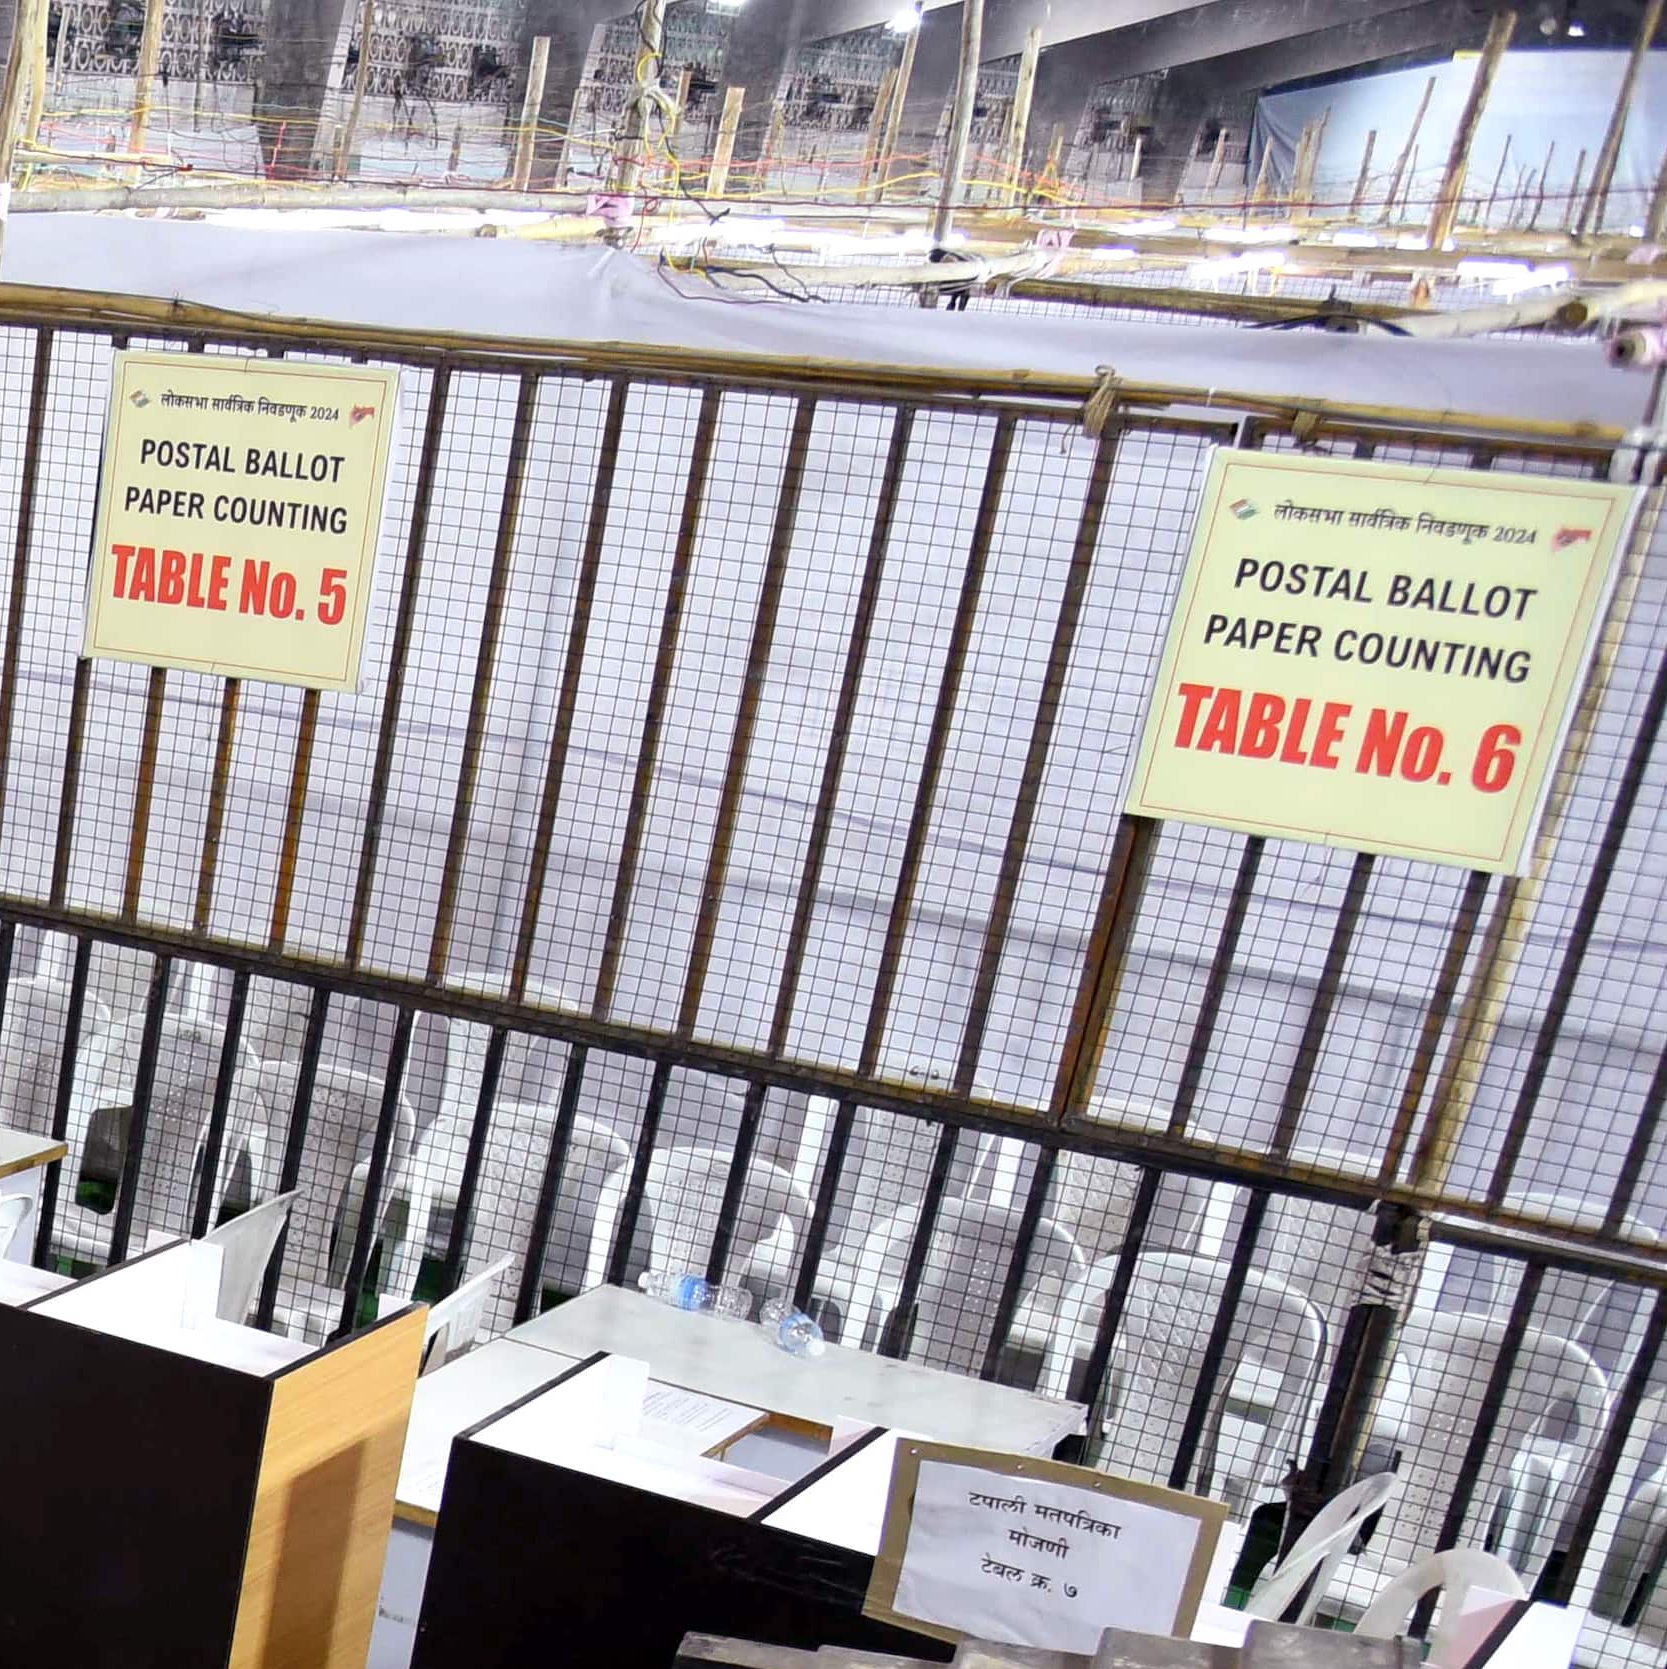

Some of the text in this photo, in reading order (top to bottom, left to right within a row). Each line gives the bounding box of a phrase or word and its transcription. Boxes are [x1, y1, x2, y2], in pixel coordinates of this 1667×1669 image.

[160, 389, 339, 423] लोकसभा सार्वत्रिक निवडणूक 2024
[141, 438, 345, 483] POSTAL BALLOT
[124, 486, 348, 534] PAPER COUNTING
[1274, 500, 1537, 545] लोकसभा सार्वत्रिक निवडणूक 2024
[111, 543, 348, 625] TABLE No. 5
[1235, 558, 1537, 621] POSTAL BALLOT
[1203, 614, 1531, 684] PAPER COUNTING
[1174, 683, 1521, 794] TABLE No. 6
[969, 1491, 1122, 1541] टपाली मतपत्रिका
[1008, 1526, 1070, 1559] मोजणी
[981, 1552, 1078, 1599] टेबल क्र. ७
